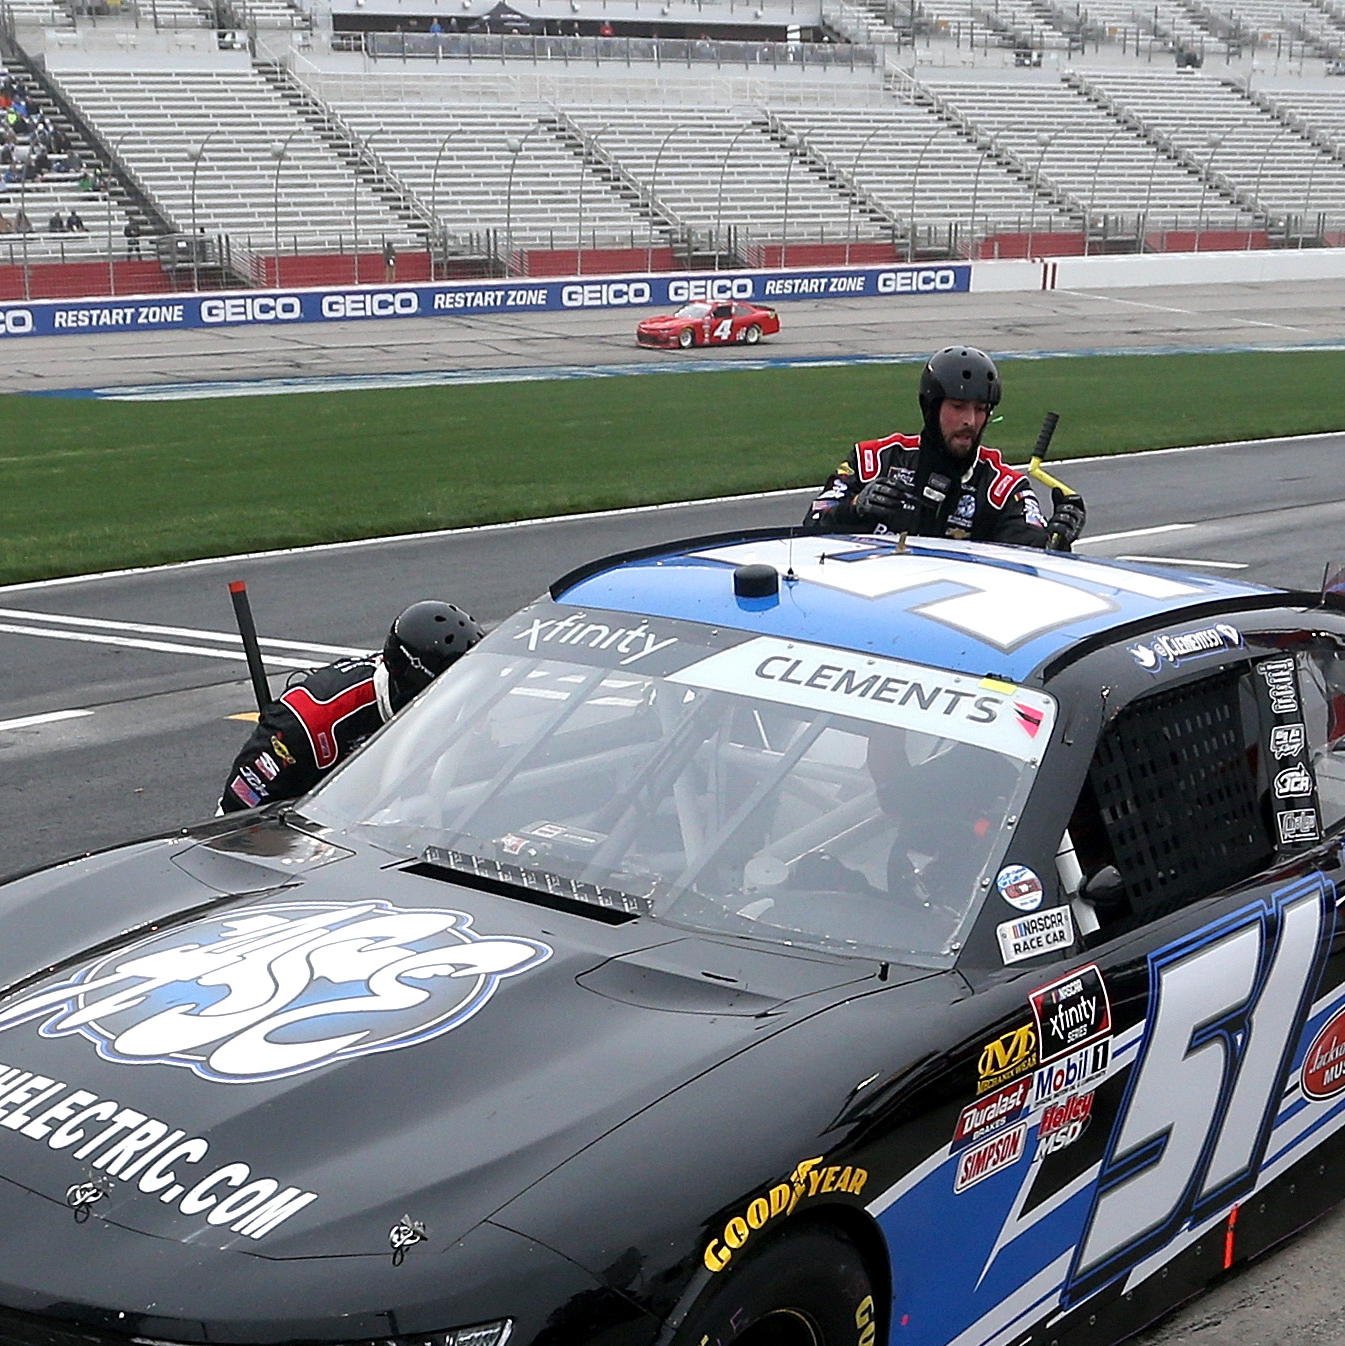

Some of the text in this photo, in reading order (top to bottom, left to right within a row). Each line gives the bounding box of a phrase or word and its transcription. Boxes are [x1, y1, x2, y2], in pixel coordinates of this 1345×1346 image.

[668, 278, 753, 301] GEICO
[765, 277, 865, 296] RESTART ZONE
[878, 270, 954, 292] GEICO
[322, 291, 418, 318] GEICO
[434, 289, 547, 310] RESTART ZONE
[562, 282, 650, 307] GEICO
[54, 304, 183, 328] RESTART ZONE
[200, 296, 301, 323] GEICO
[714, 319, 733, 340] 4
[513, 613, 679, 666] xfinity
[754, 654, 1004, 725] CLEMENTS
[1023, 911, 1064, 935] NASCAR
[1014, 930, 1066, 955] RACE CAR
[1049, 995, 1097, 1040] xfinity
[1067, 1023, 1088, 1043] SERIES
[1035, 1051, 1089, 1101] Mobil
[1096, 1045, 1104, 1070] 1
[1070, 888, 1328, 1279] 51
[962, 1083, 1025, 1136] Duralast
[960, 1128, 1023, 1185] SIMPSON
[704, 1155, 869, 1273] GOODYEAR
